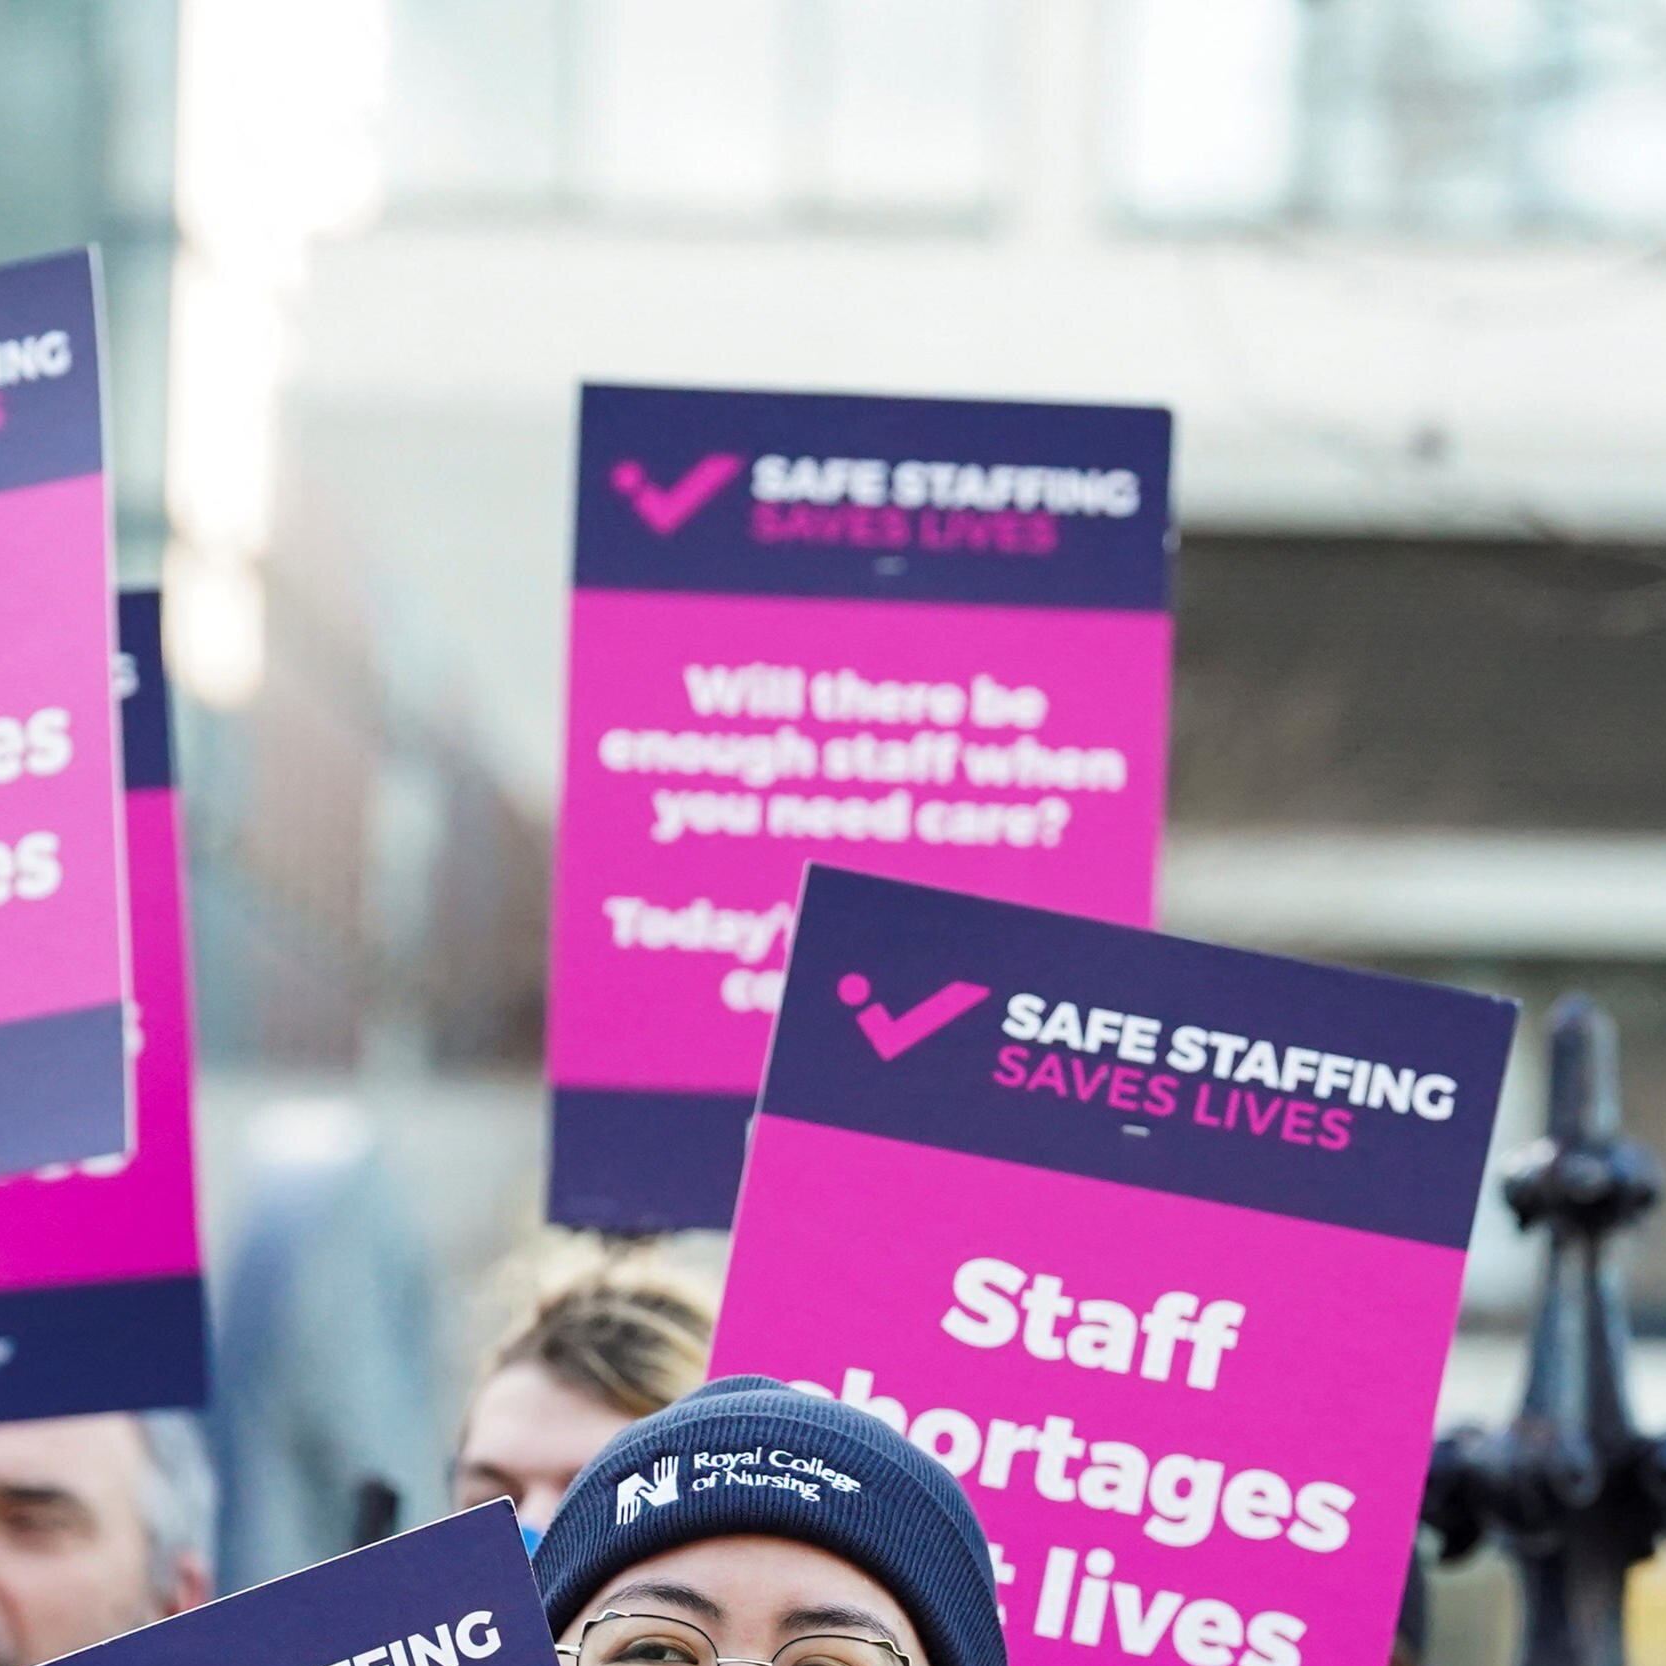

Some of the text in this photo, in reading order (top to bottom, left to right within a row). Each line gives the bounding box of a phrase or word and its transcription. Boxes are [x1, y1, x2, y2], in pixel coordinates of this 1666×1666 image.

[751, 453, 1141, 519] SAFE STAFFING
[750, 500, 1058, 554] SAVES LIVES
[683, 661, 1050, 729] Will there be
[598, 725, 1128, 793] enough staff when
[650, 787, 1072, 849] you need care?
[602, 895, 795, 964] Today'
[1001, 993, 1458, 1122] SAFE STAFFING
[992, 1044, 1355, 1152] SAVES LIVES
[940, 1256, 1247, 1392] Staff
[691, 1468, 821, 1502] of Nursing
[692, 1446, 862, 1494] Royal College
[786, 1366, 1357, 1554] hortages
